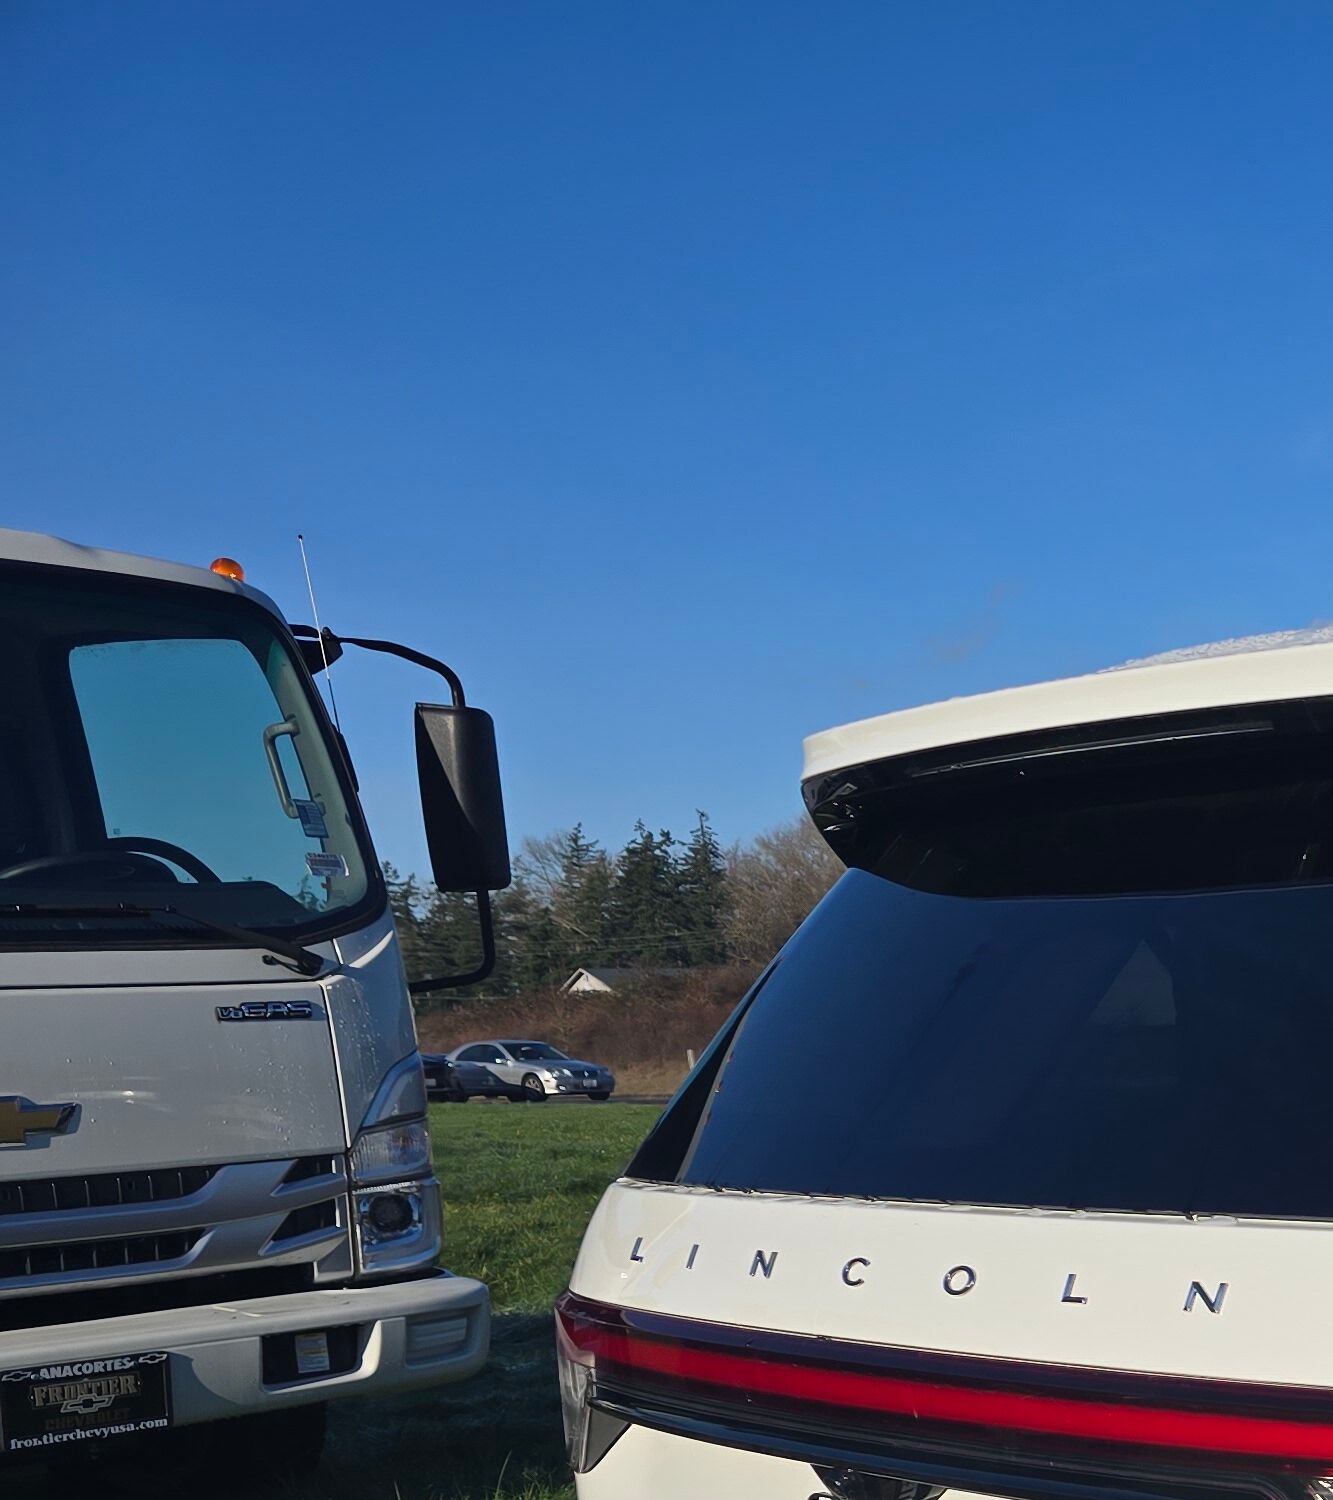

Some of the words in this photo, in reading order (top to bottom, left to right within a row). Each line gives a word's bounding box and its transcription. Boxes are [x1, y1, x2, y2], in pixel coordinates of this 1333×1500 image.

[629, 1236, 1229, 1314] LINCOLN
[39, 1356, 135, 1380] ANACORTES
[33, 1374, 138, 1407] FRONTIER
[45, 1407, 130, 1430] CHEVROLET
